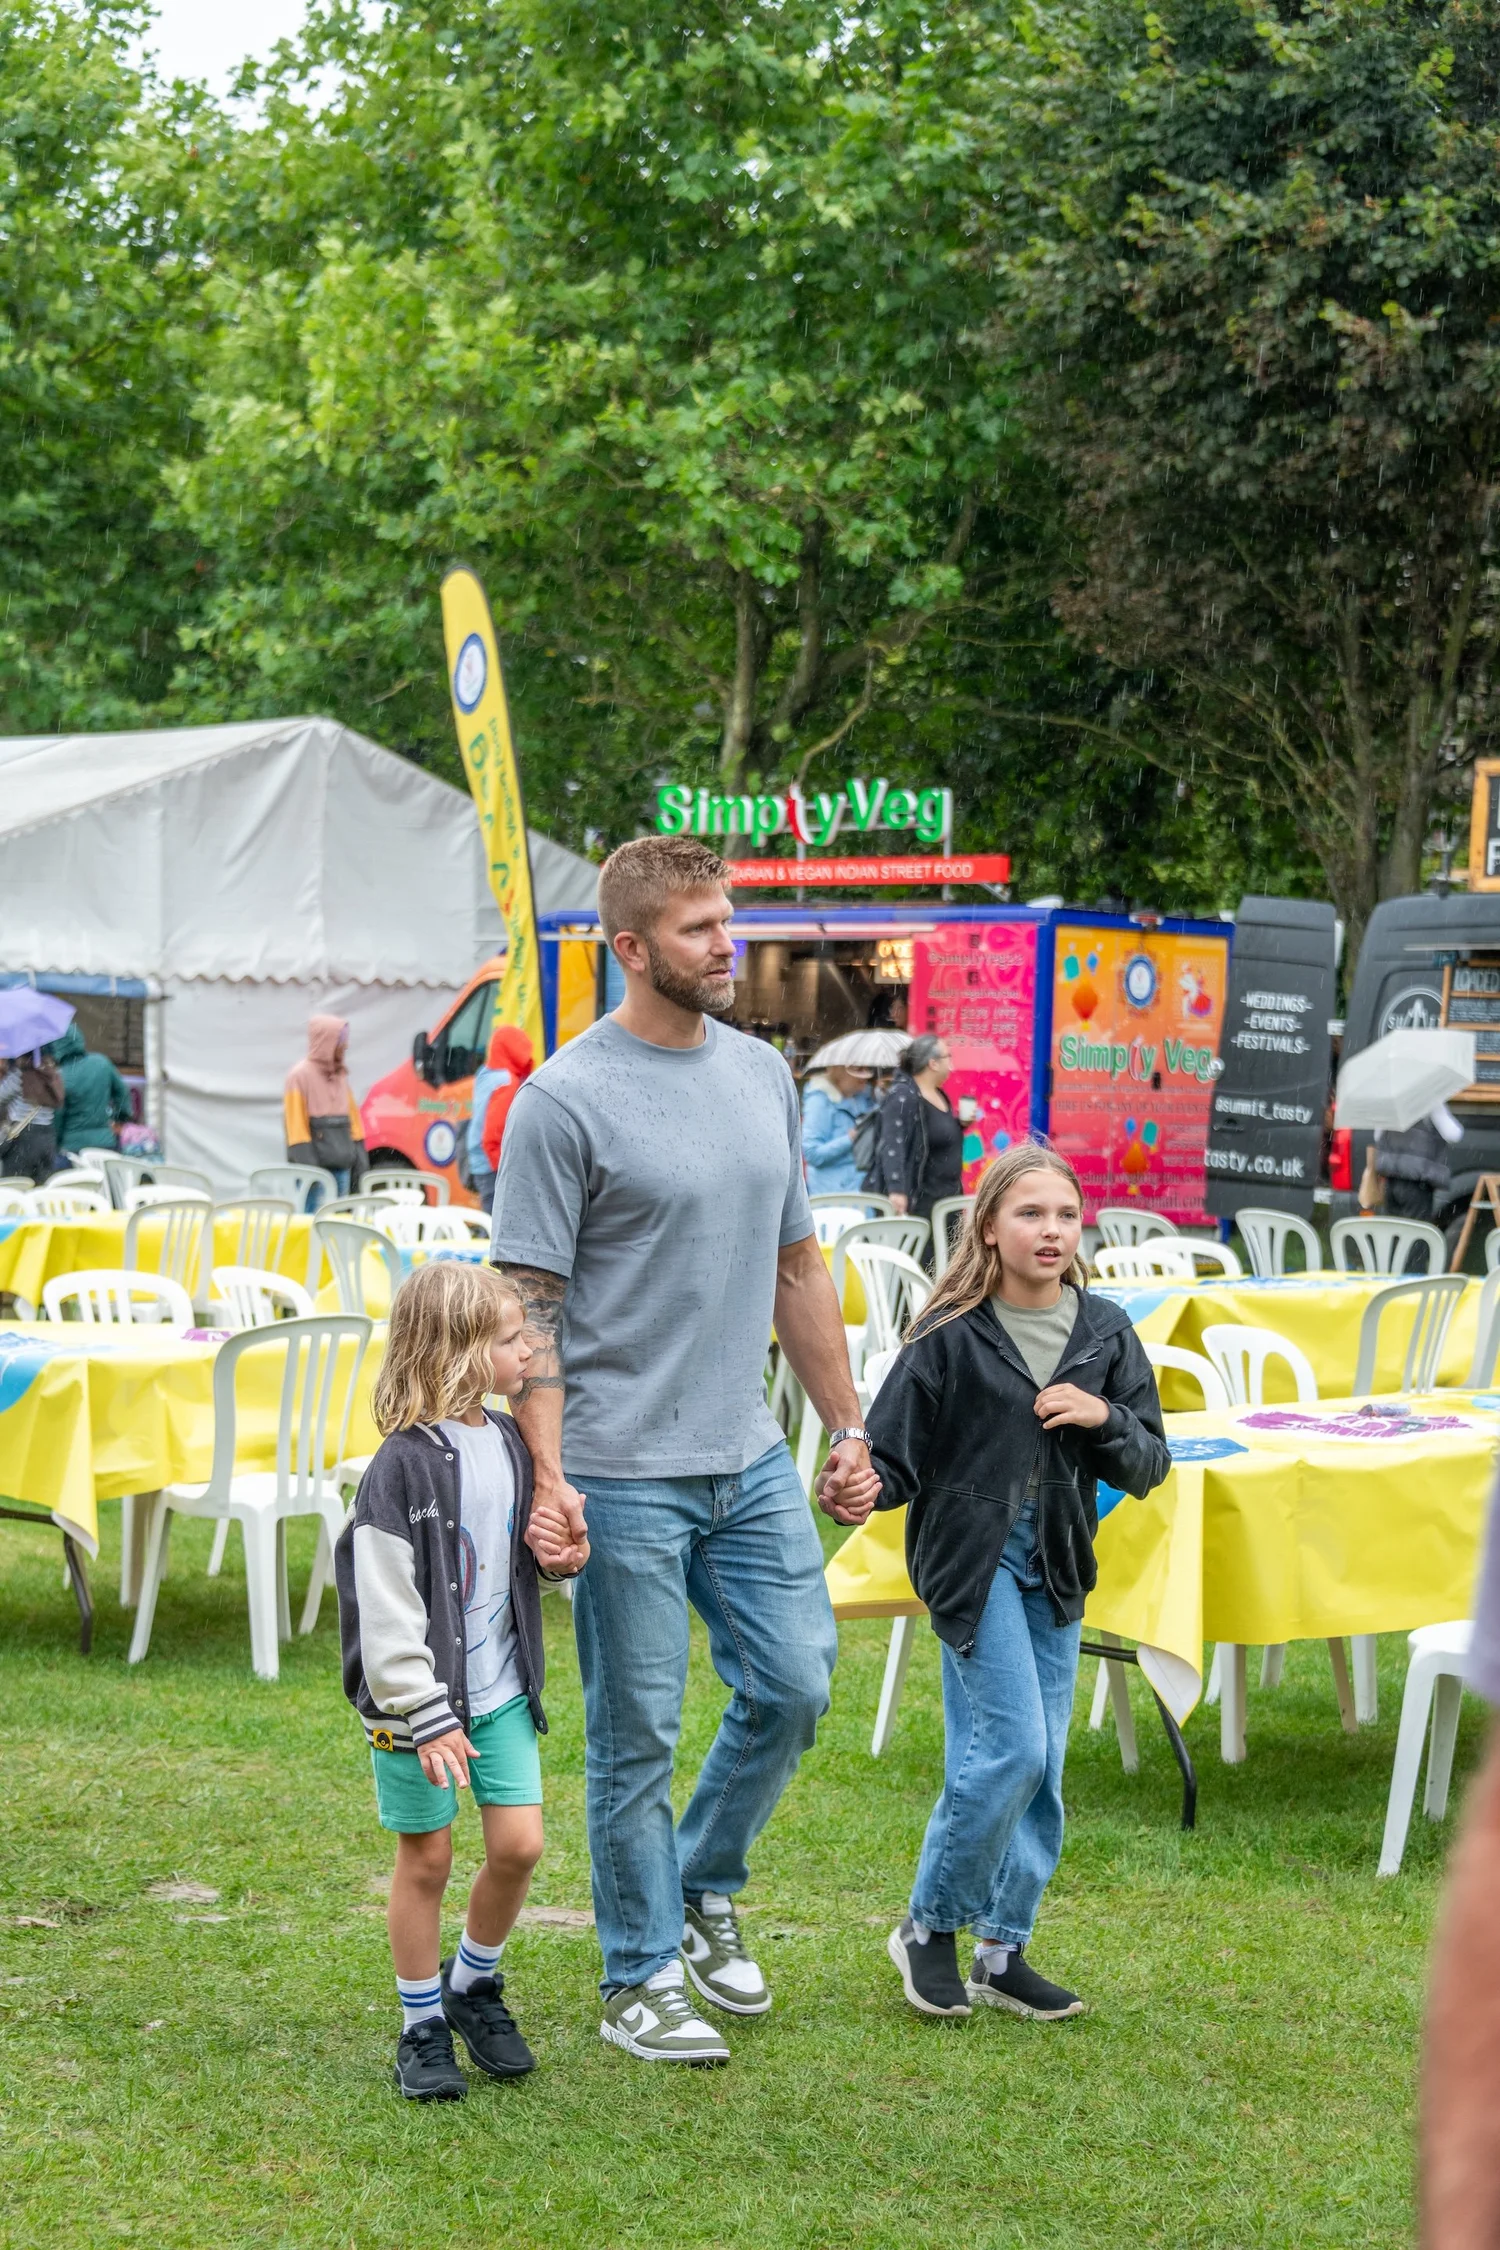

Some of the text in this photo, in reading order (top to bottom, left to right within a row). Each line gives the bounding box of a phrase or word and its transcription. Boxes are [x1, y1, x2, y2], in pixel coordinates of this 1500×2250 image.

[776, 865, 786, 881] &
[788, 864, 832, 880] VEGAN
[834, 863, 878, 880] INDIAN
[880, 862, 932, 879] STREET
[934, 861, 974, 878] FOOD
[1060, 1034, 1215, 1083] Simply Veg
[1215, 1096, 1314, 1124] @summit_tasty
[1204, 1148, 1305, 1178] tasty.co.uk
